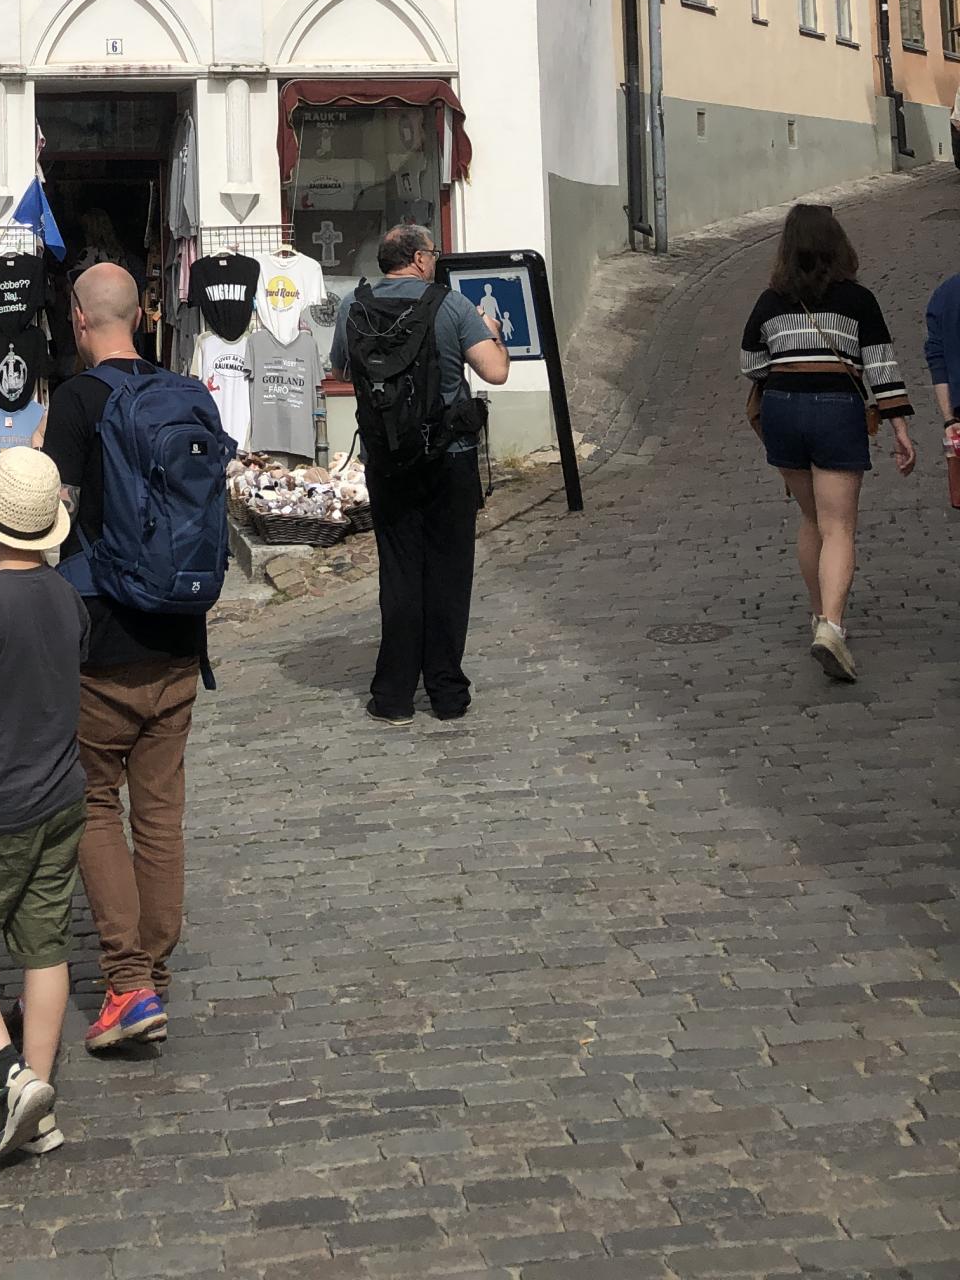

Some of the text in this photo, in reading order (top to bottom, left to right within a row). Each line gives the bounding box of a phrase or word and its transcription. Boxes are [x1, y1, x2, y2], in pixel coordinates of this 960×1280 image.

[112, 40, 118, 53] 6
[280, 287, 300, 300] Rauk
[262, 375, 305, 387] GOTLAND
[191, 581, 201, 591] 25
